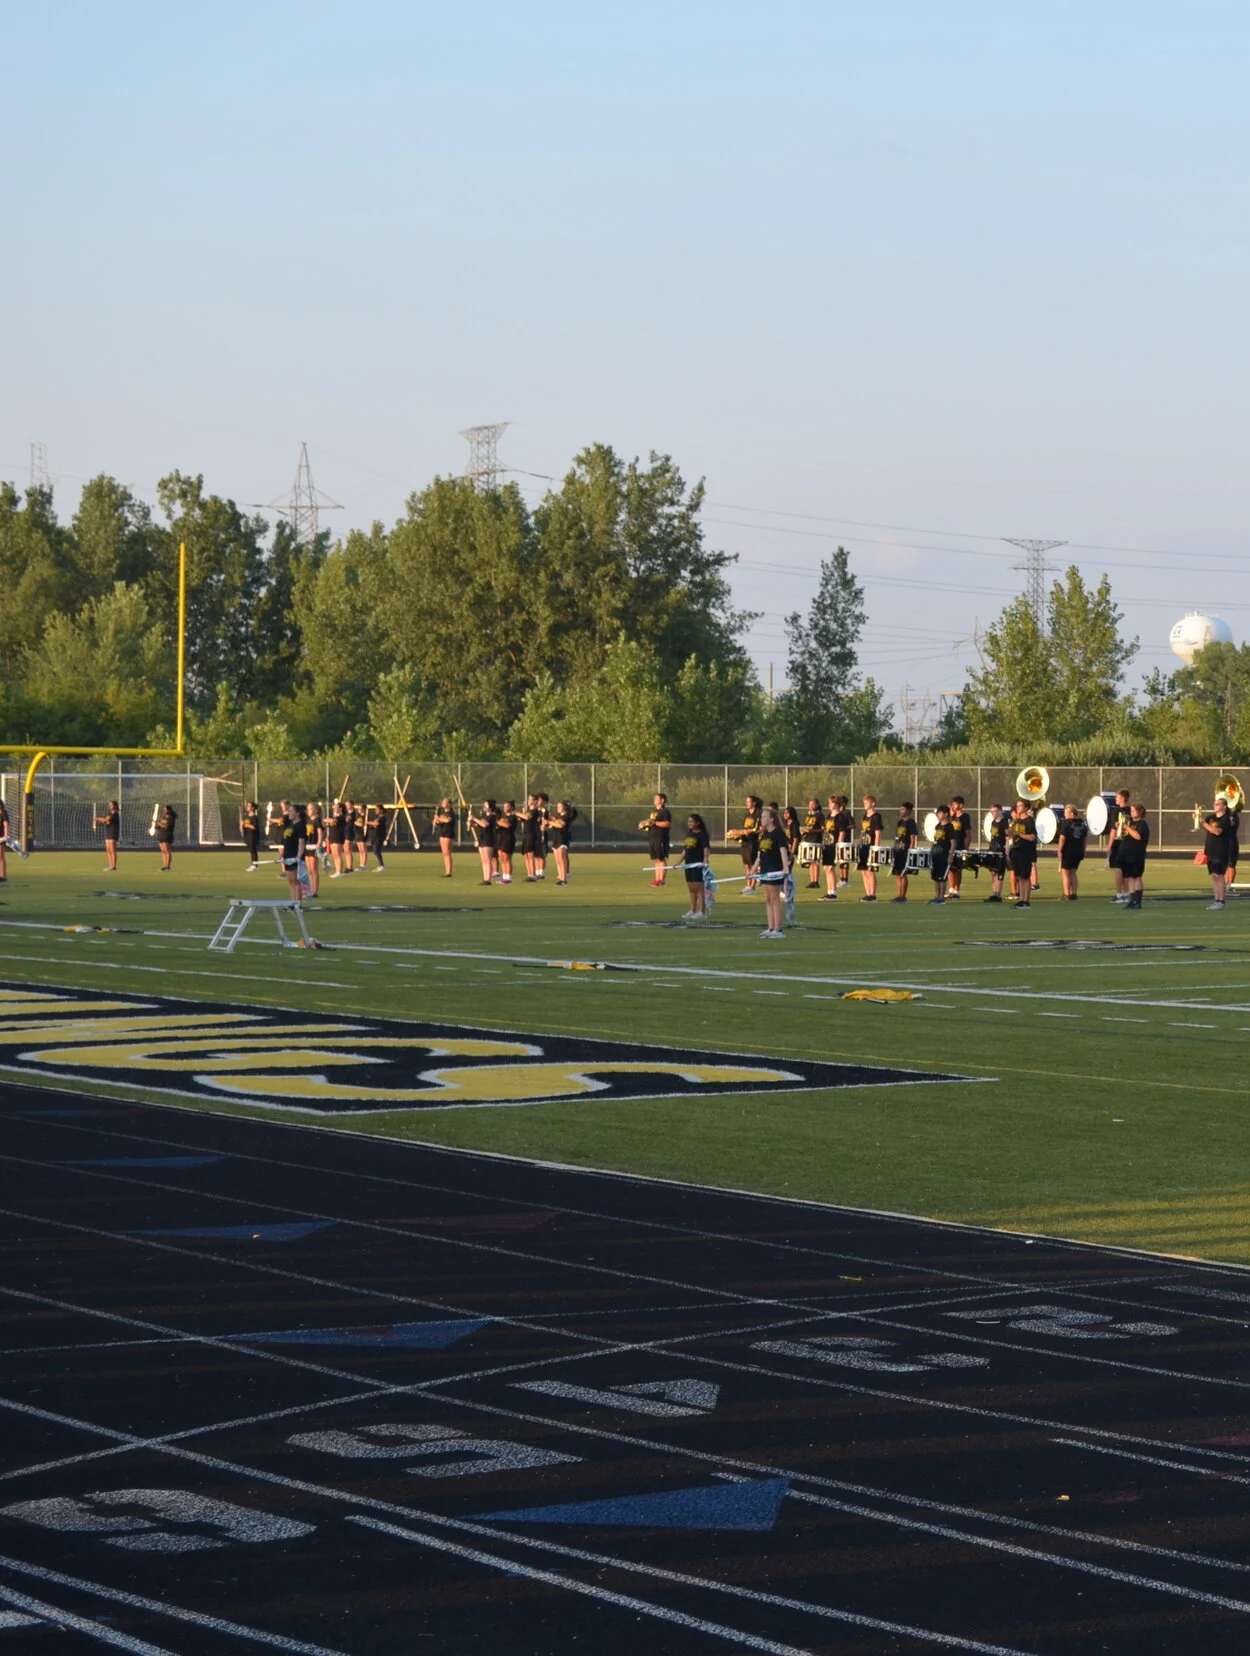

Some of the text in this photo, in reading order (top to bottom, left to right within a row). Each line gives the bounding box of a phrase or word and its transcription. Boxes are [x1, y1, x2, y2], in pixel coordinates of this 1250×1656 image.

[937, 1305, 1181, 1339] 2
[749, 1337, 990, 1372] 3
[506, 1379, 721, 1417] 4
[285, 1423, 587, 1479] 5
[0, 1489, 317, 1552] 6
